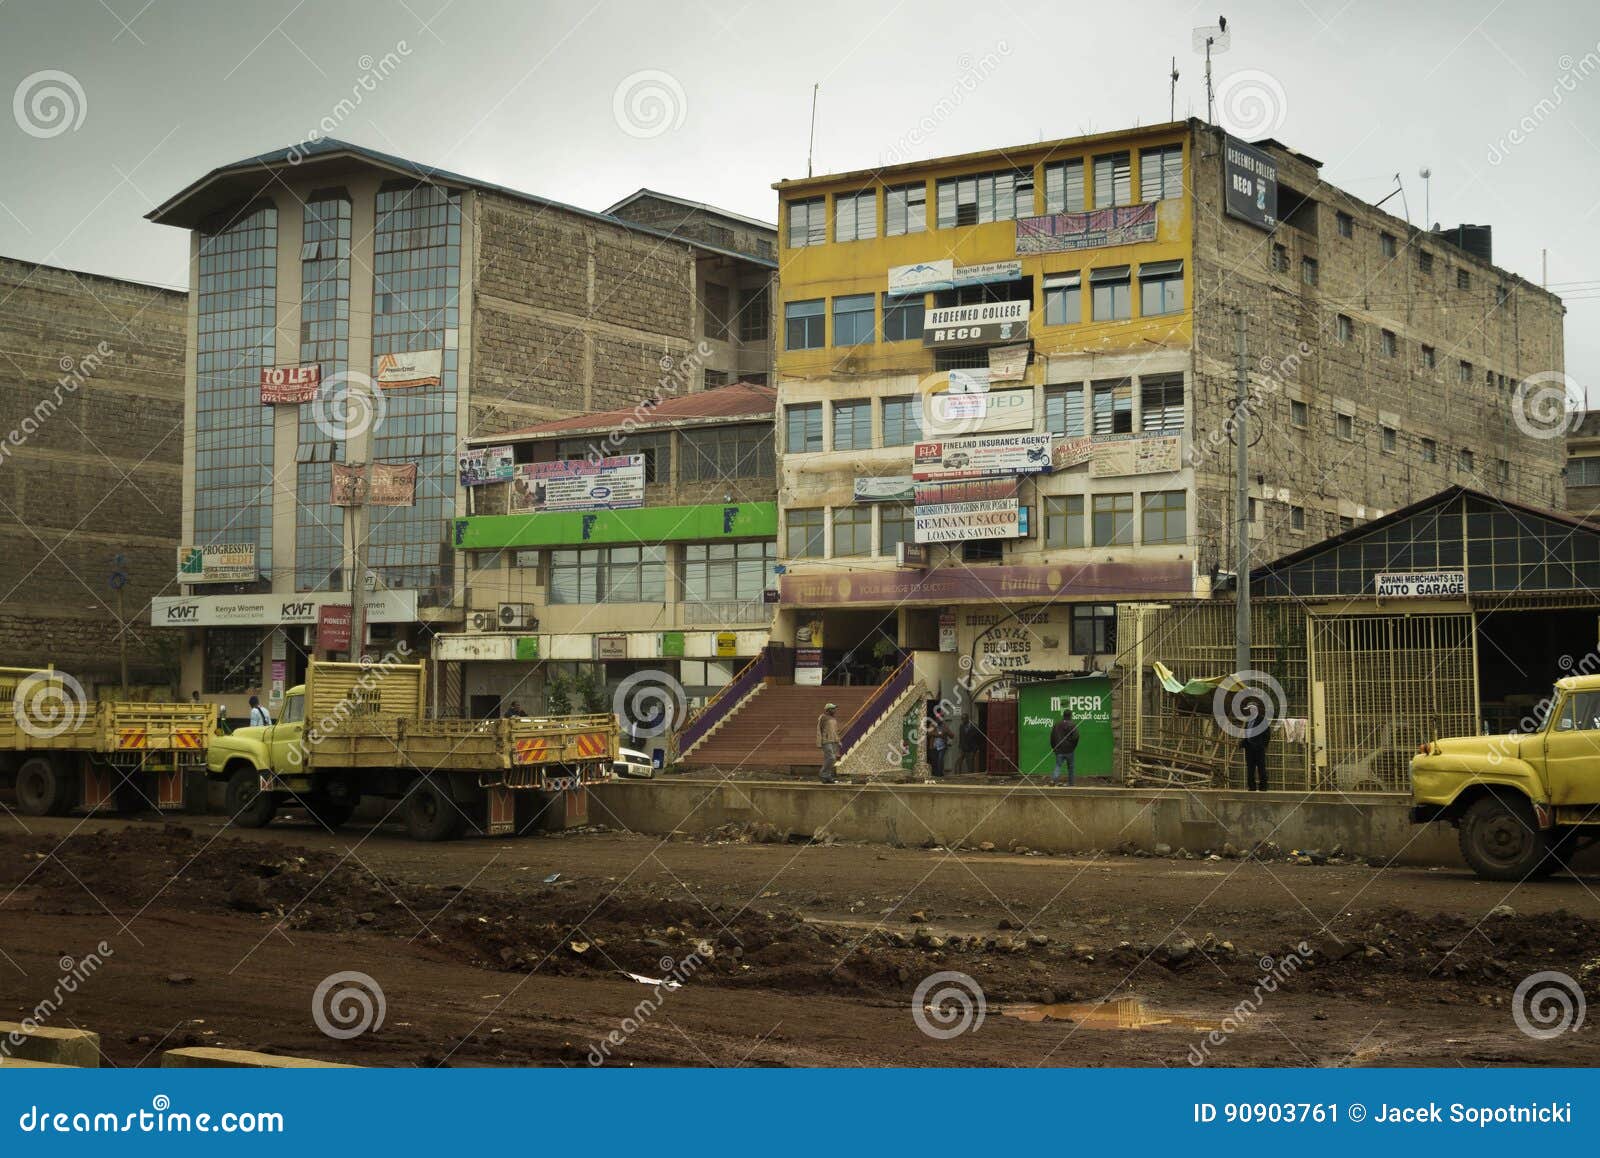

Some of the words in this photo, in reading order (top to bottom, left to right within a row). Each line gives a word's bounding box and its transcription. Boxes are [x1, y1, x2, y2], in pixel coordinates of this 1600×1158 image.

[1228, 147, 1254, 172] REDEEMED
[1256, 160, 1275, 182] COLLEGE
[1233, 174, 1252, 196] RECO
[932, 307, 979, 324] REDEEMED
[982, 304, 1021, 320] COLLEGE
[934, 327, 981, 342] RECO
[263, 367, 285, 385] TO
[288, 365, 319, 384] LET
[943, 440, 977, 450] FINELAND
[979, 438, 1020, 447] INSURANCE
[1021, 435, 1050, 444] AGENCY
[915, 504, 943, 516] ADMISSION
[944, 504, 950, 514] IN
[951, 503, 979, 513] PROGRESS
[917, 515, 975, 529] REMNANT
[976, 513, 1016, 525] SACCO
[927, 530, 957, 541] LOANS
[958, 529, 965, 539] &
[967, 526, 1007, 538] SAVINGS
[203, 544, 254, 555] PROGRESSIVE
[1381, 575, 1404, 585] SWANI
[1405, 574, 1449, 583] MERCHANTS
[1450, 574, 1464, 583] LTD
[1378, 584, 1409, 595] AUTO
[1416, 583, 1464, 595] GARAGE
[216, 605, 236, 613] Kenya
[238, 604, 264, 612] Women
[984, 627, 1029, 641] ROYAL
[983, 641, 1032, 653] BUSINESS
[984, 654, 1030, 667] CENTRE
